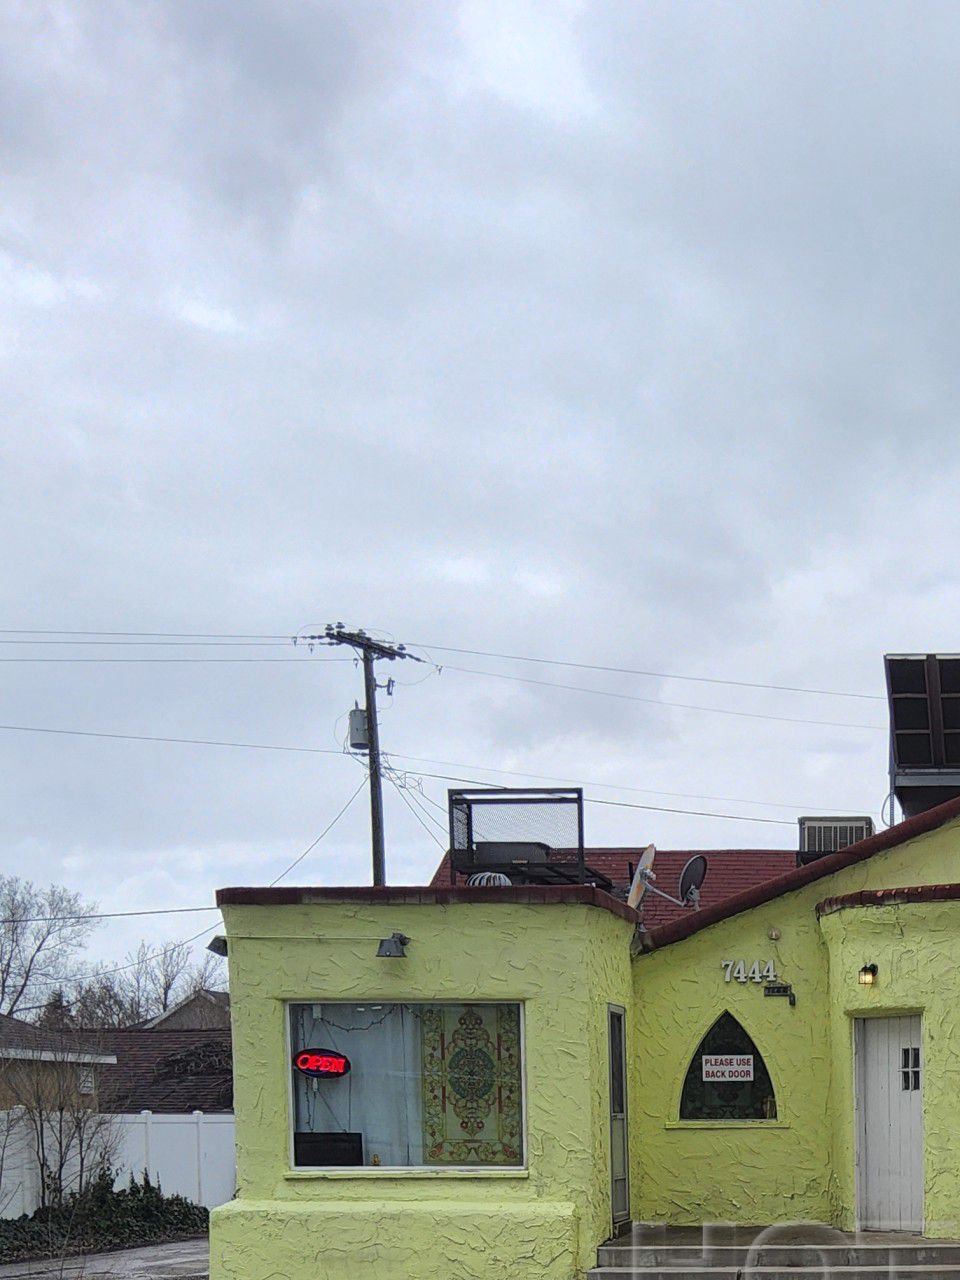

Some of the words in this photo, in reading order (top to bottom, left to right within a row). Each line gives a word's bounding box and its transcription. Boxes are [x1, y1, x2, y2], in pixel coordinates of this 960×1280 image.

[721, 960, 778, 983] 7444
[297, 1054, 345, 1073] OPEN
[704, 1058, 734, 1067] PLEASE
[736, 1058, 751, 1067] USE
[705, 1070, 726, 1079] BACK
[728, 1070, 751, 1079] DOOR
